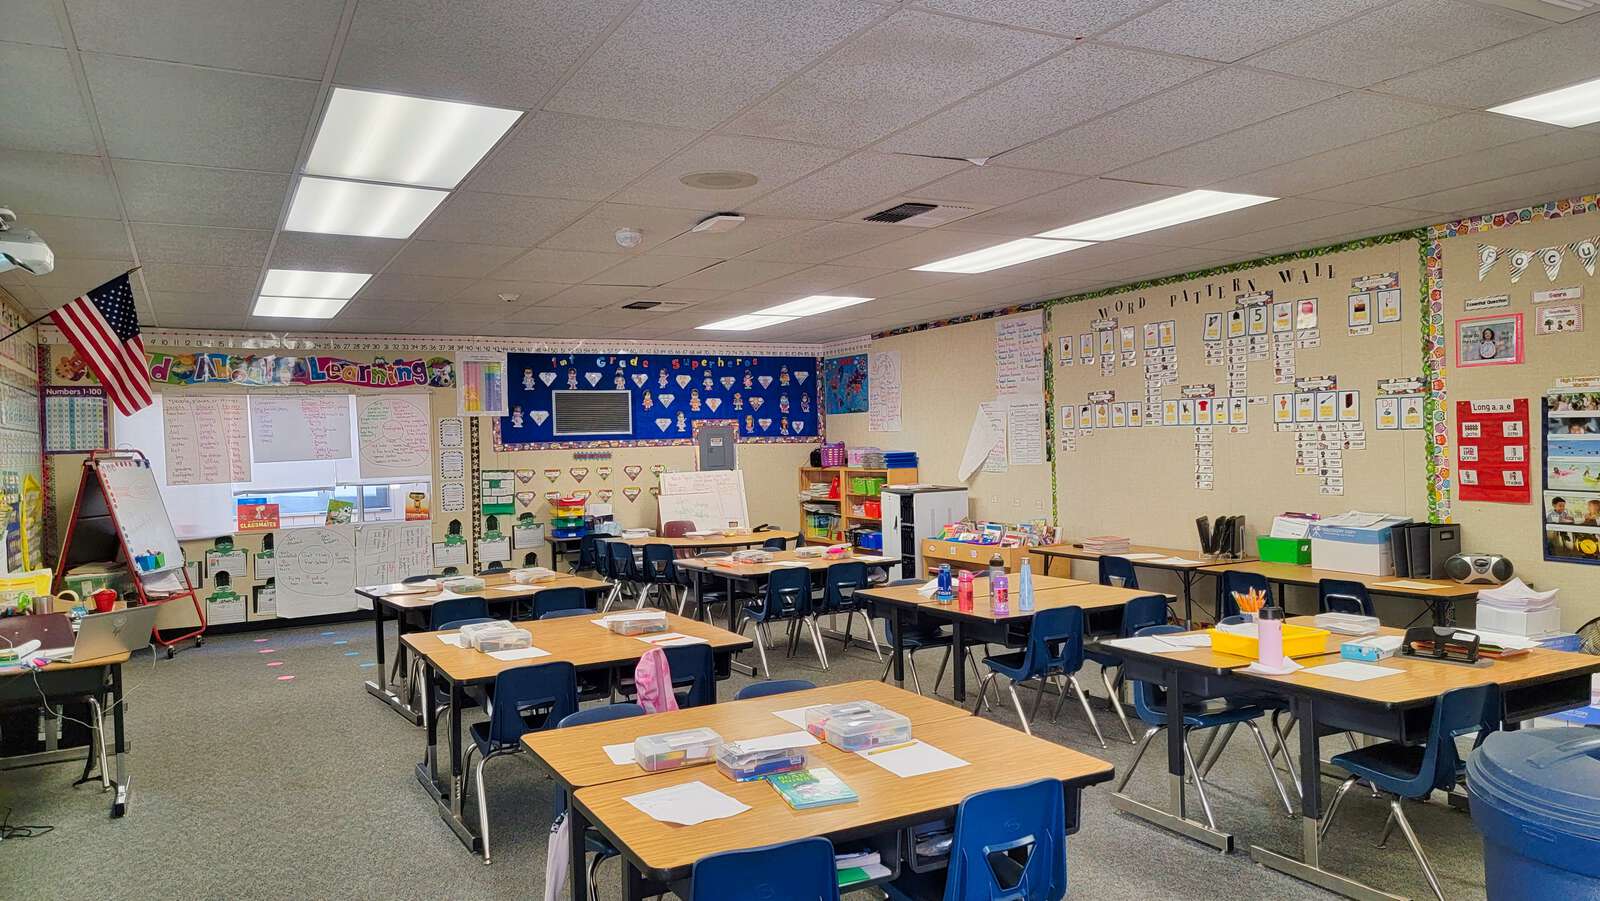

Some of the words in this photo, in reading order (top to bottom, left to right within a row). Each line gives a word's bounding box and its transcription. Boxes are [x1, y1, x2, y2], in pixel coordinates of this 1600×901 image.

[1098, 296, 1146, 320] WORD
[1170, 278, 1256, 307] PATTERN
[1279, 262, 1336, 284] WALL
[1254, 308, 1263, 322] 5
[596, 356, 649, 368] Grade
[306, 356, 430, 385] Learning
[1473, 403, 1490, 411] Long
